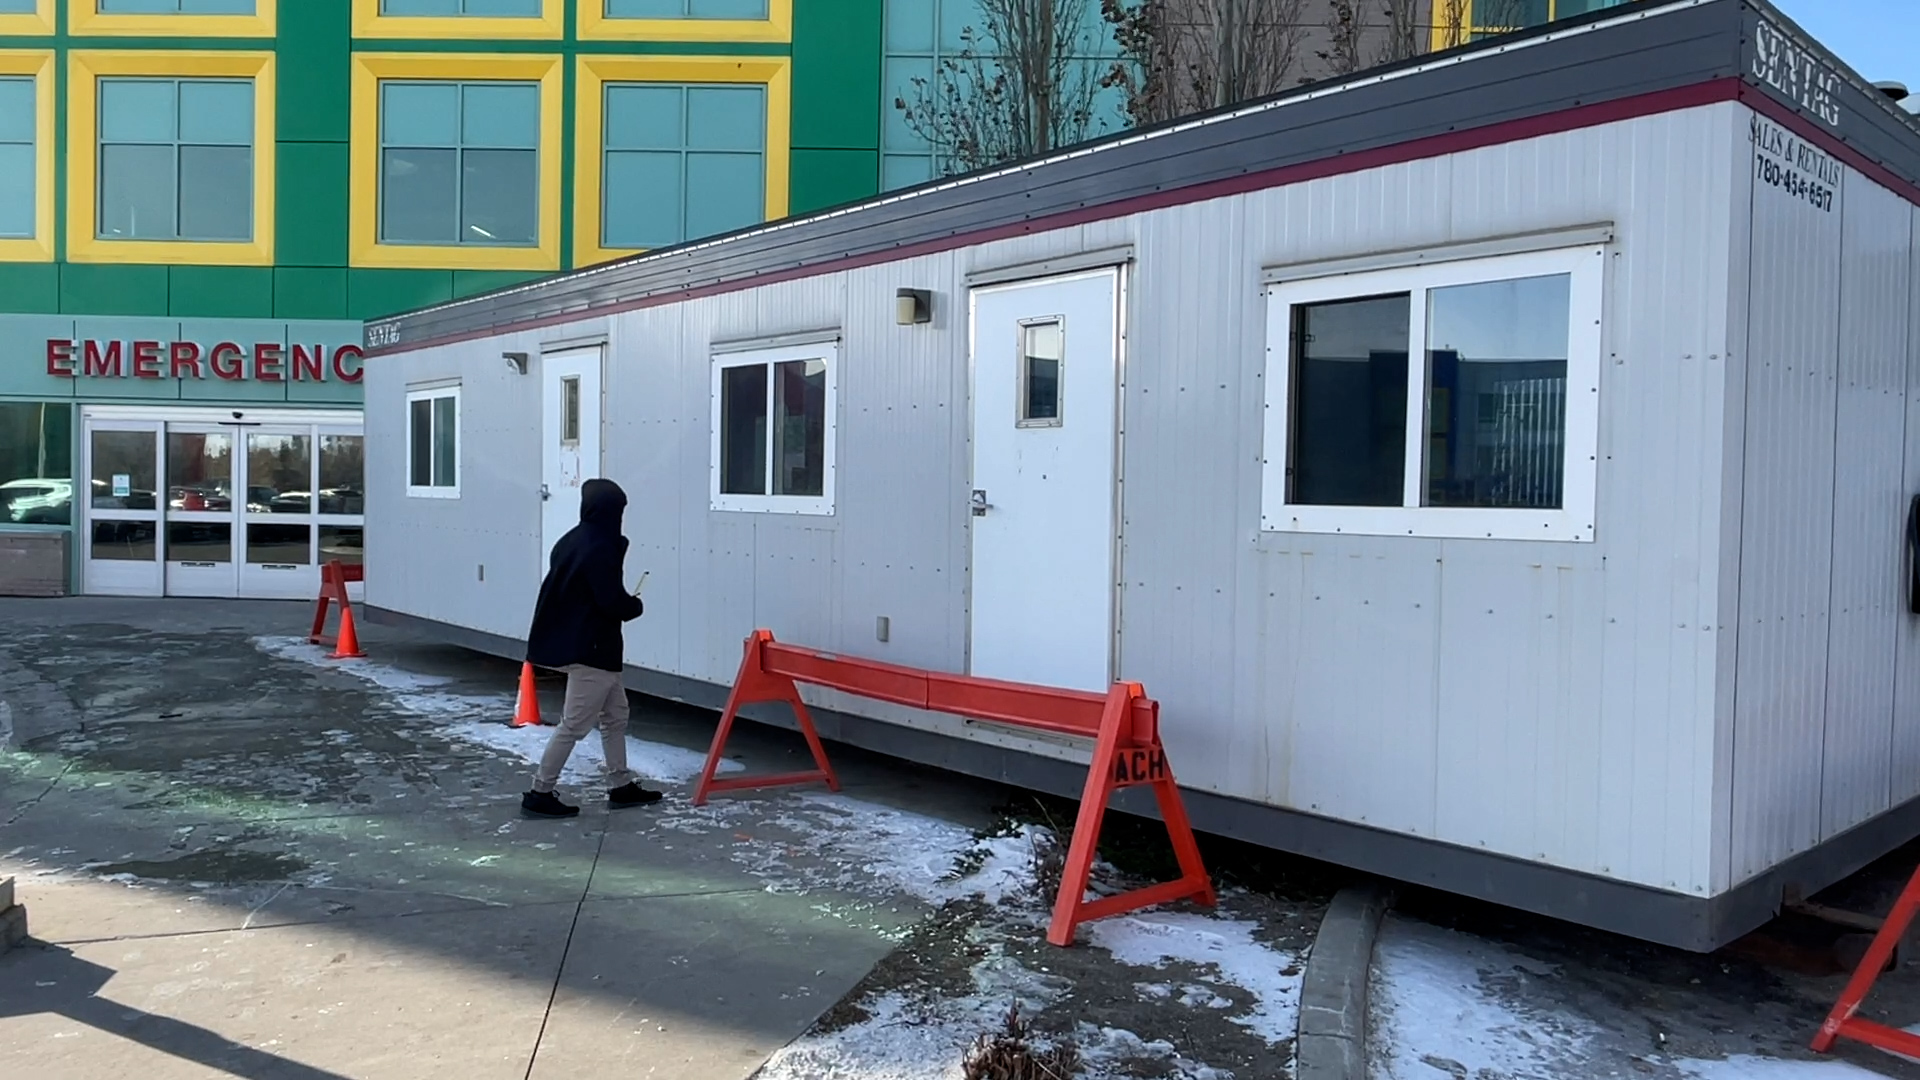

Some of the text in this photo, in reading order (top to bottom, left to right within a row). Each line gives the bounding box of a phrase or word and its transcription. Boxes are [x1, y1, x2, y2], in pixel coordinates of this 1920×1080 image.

[1748, 115, 1840, 188] SALES & RENTALS
[1757, 155, 1832, 213] 780-454-6517
[46, 338, 363, 383] EMERGENC
[1115, 749, 1164, 782] ACH
